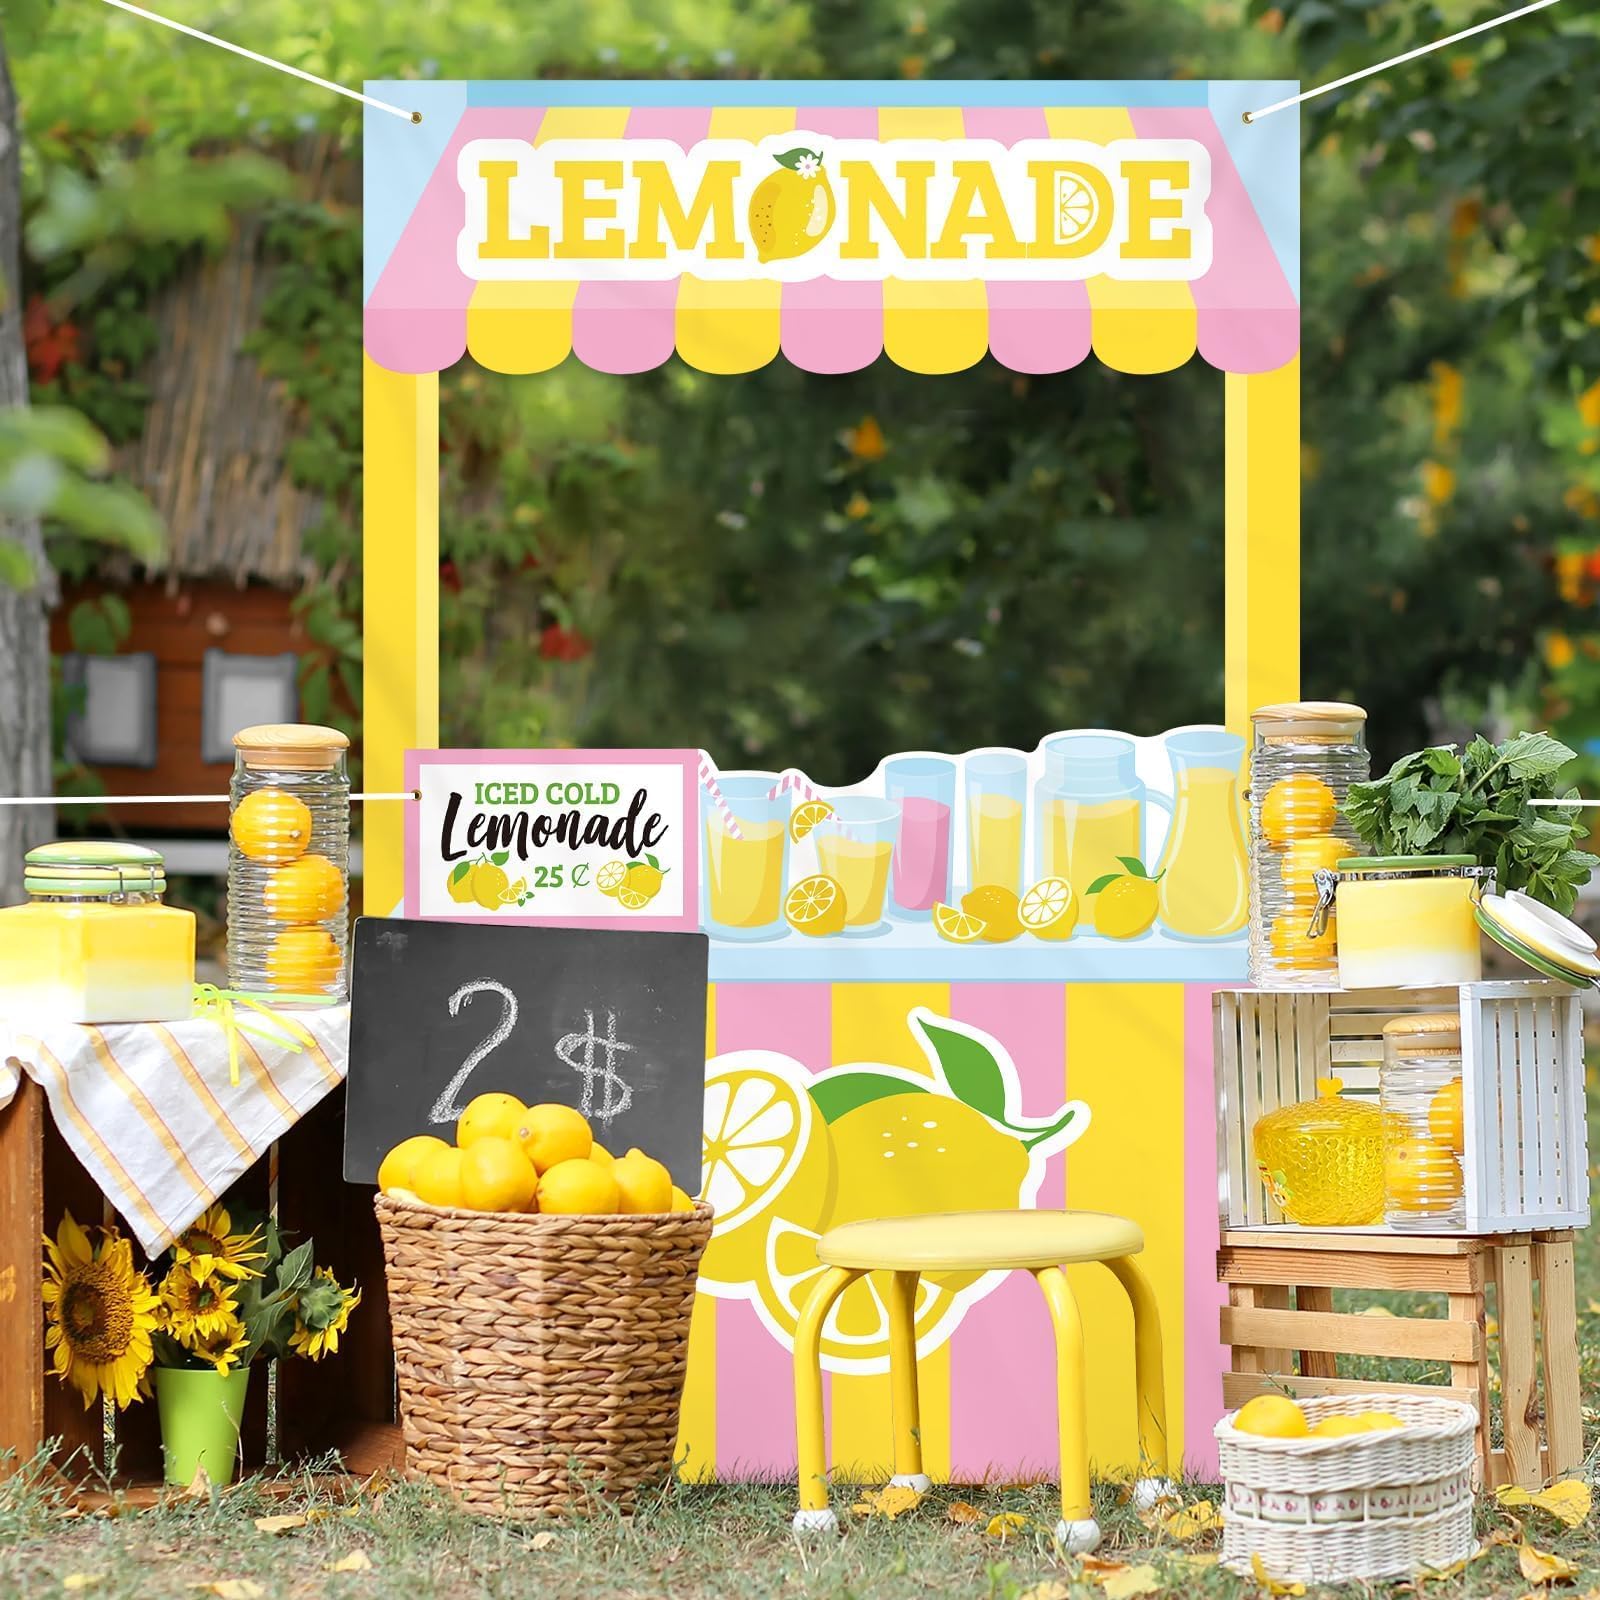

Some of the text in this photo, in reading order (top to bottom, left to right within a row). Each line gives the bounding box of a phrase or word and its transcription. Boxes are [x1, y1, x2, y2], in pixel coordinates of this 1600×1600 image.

[478, 147, 1192, 264] LEMONADE
[441, 788, 669, 861] Lemonade
[474, 782, 620, 805] ICED COLD
[534, 864, 564, 888] 25
[428, 977, 636, 1125] 2 $
